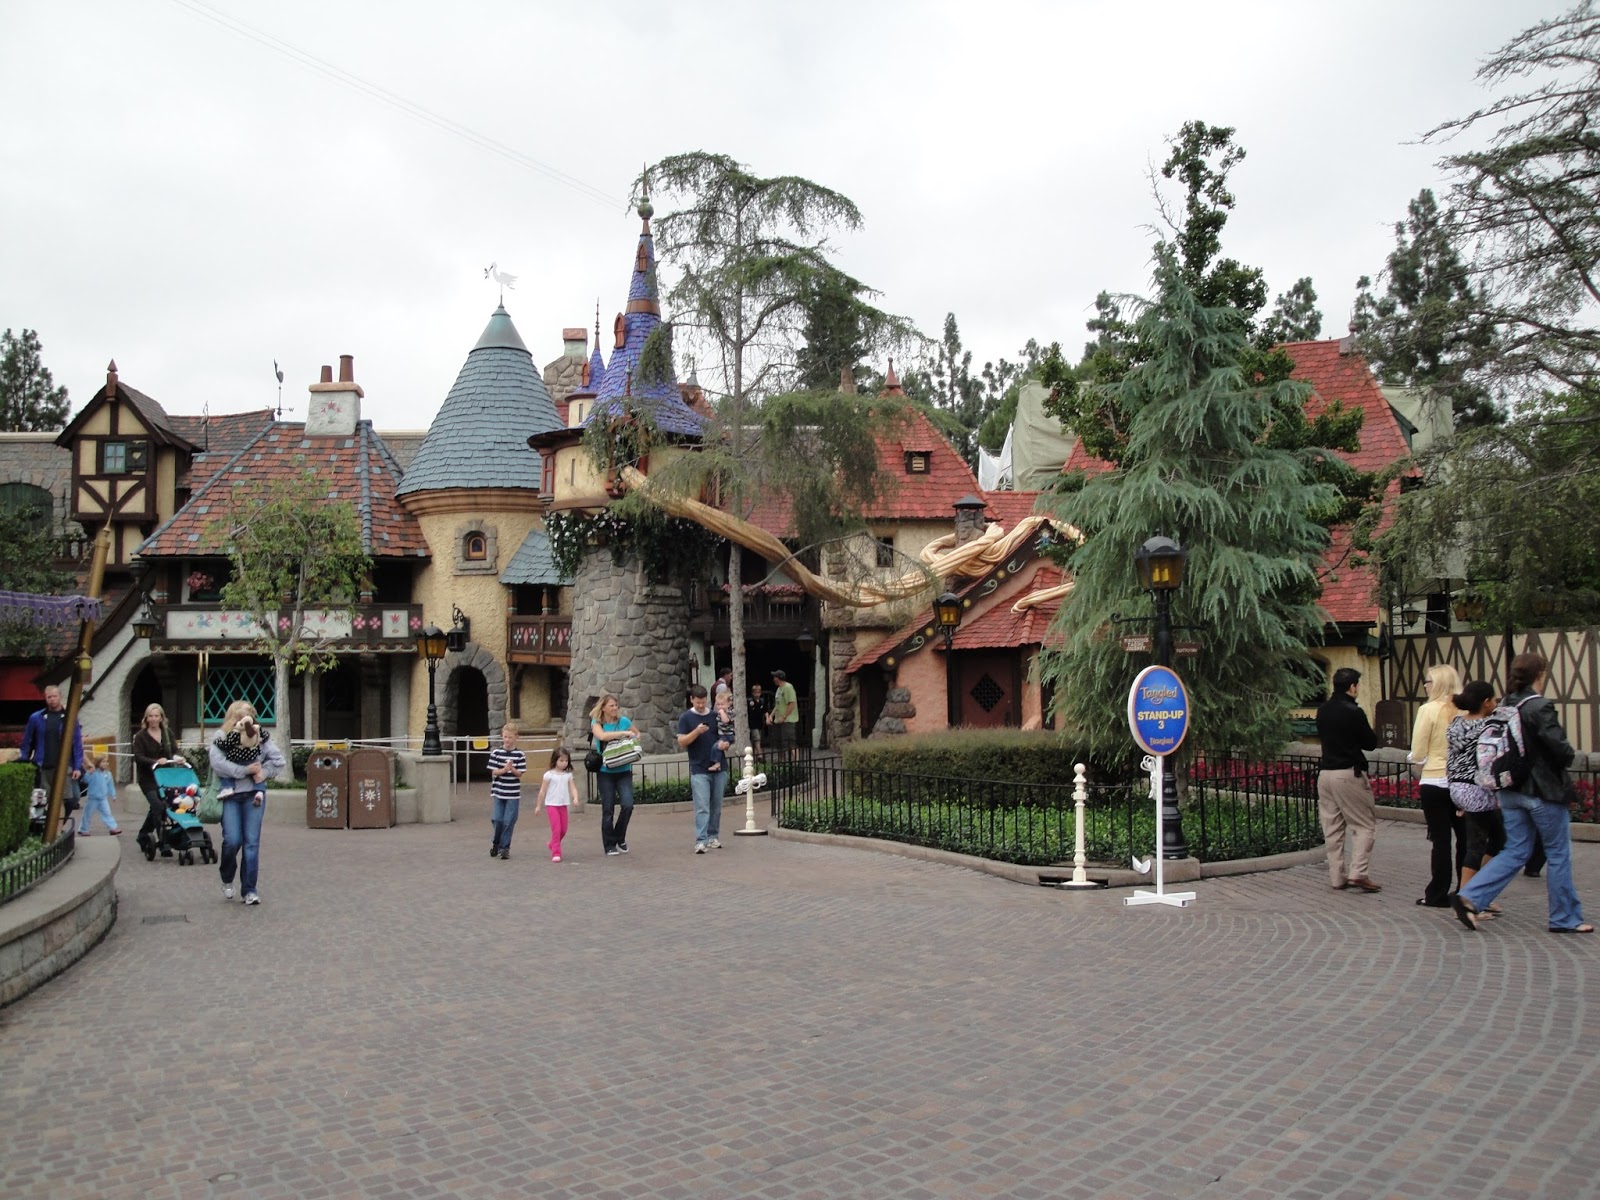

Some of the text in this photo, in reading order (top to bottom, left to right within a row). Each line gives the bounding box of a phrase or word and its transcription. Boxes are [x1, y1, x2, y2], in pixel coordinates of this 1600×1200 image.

[1140, 685, 1177, 704] Tangled
[1138, 710, 1184, 720] STAND-UP
[1158, 720, 1165, 729] 3
